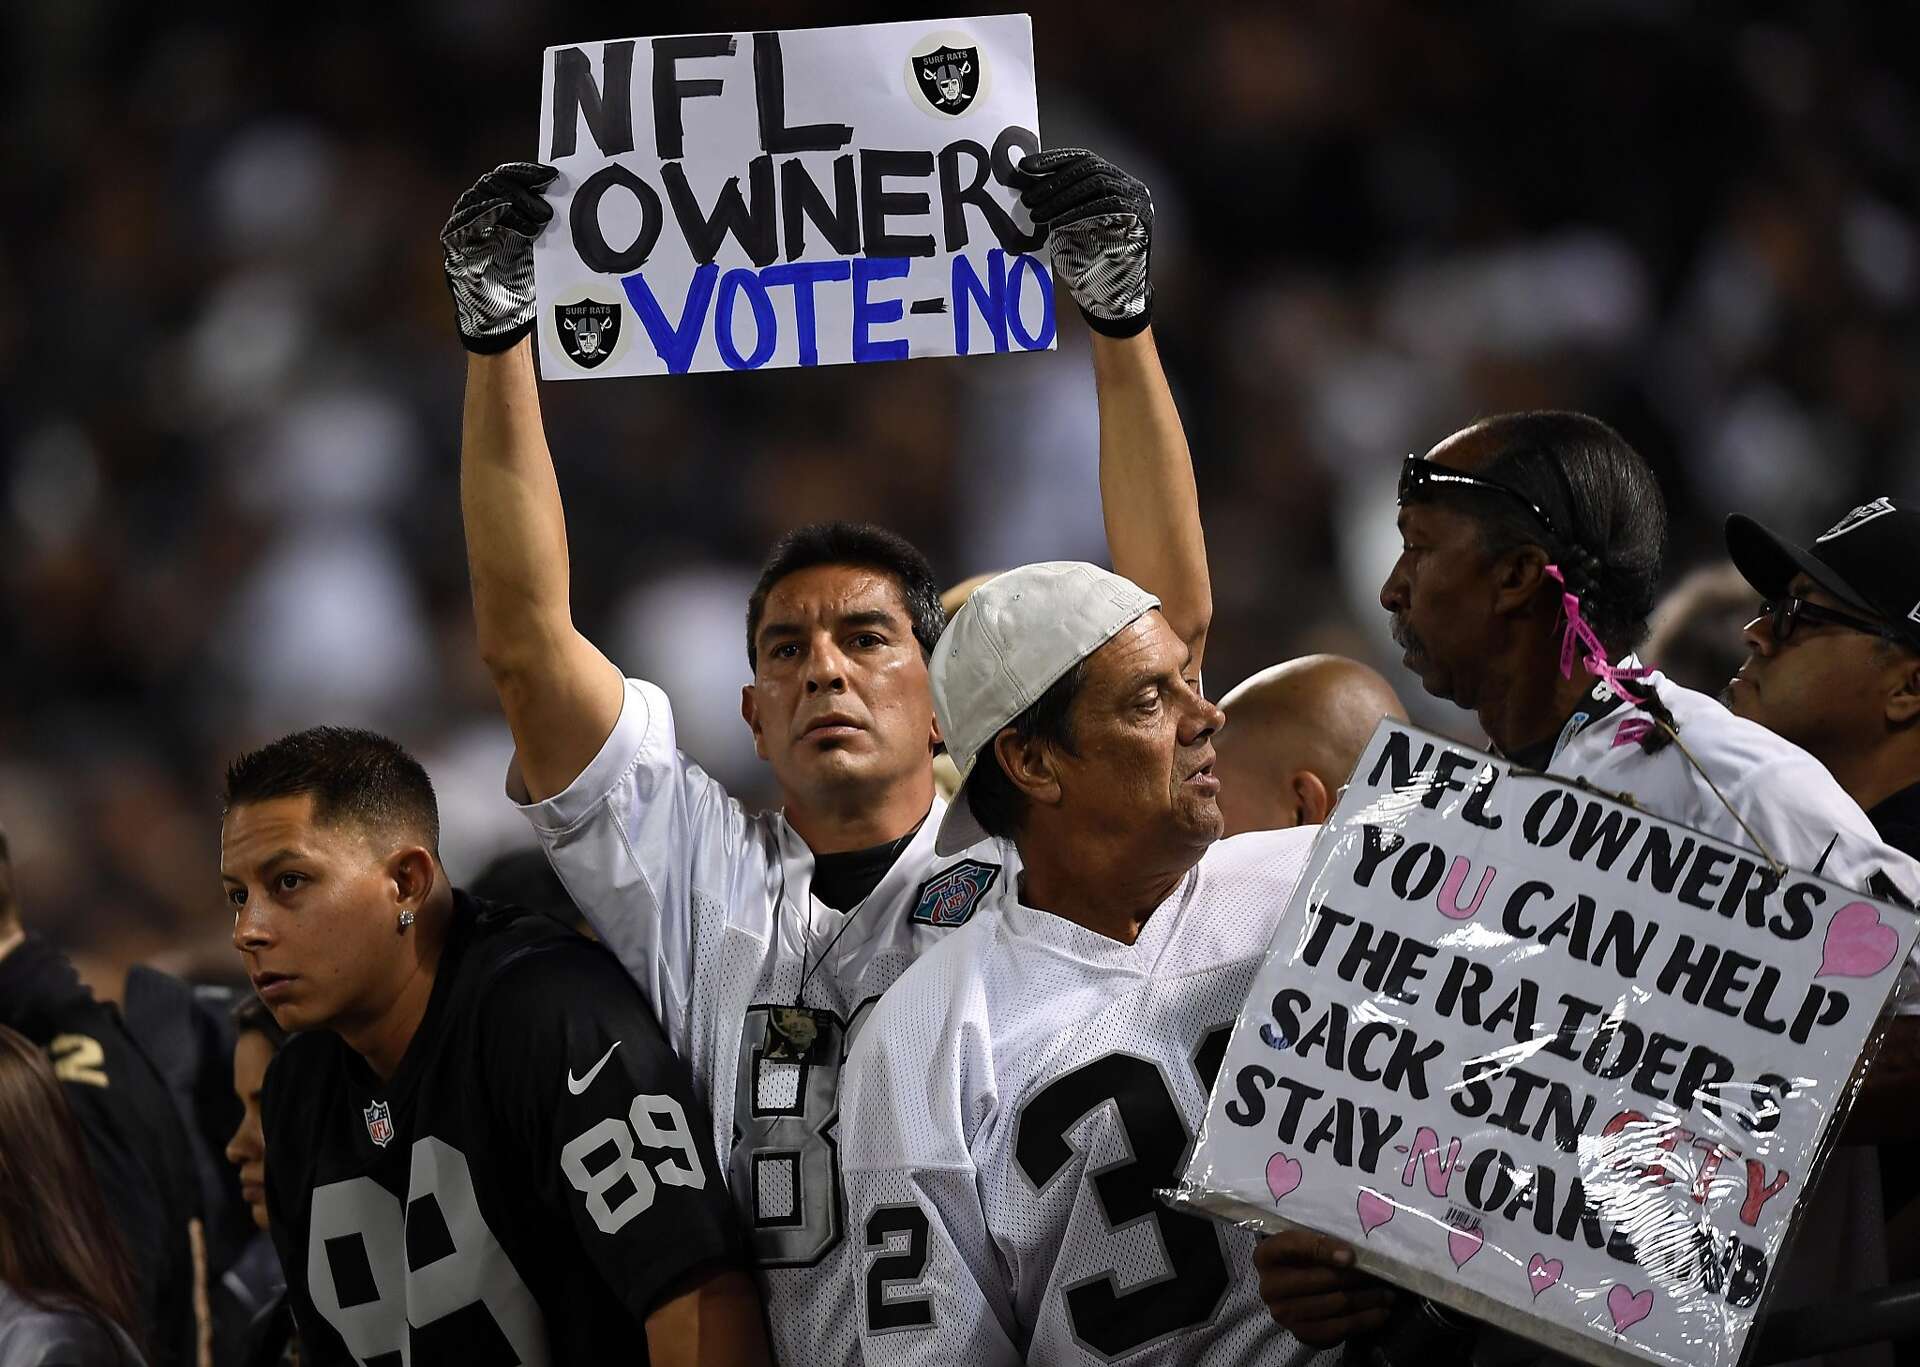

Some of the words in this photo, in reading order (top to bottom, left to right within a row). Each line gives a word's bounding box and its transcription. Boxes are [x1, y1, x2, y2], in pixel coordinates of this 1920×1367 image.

[550, 31, 854, 161] NFL
[923, 54, 945, 65] SURF
[946, 50, 968, 61] RATS
[570, 126, 1051, 273] OWNERS
[565, 306, 588, 315] SURF
[589, 306, 611, 314] RATS
[621, 248, 1057, 374] VOTE-NO
[1366, 731, 1503, 830] NFL
[1522, 788, 1827, 943] OWNERS
[1353, 824, 1497, 919] YOU
[1501, 880, 1659, 979] CAN
[1655, 943, 1851, 1044] HELP
[1259, 988, 1445, 1100] SACK
[1450, 1058, 1597, 1155] SIN
[1297, 903, 1439, 1005] THE
[1434, 955, 1794, 1134] RAIDERS
[560, 1094, 707, 1234] 89
[1012, 1020, 1237, 1363] 3
[863, 1201, 939, 1337] 2
